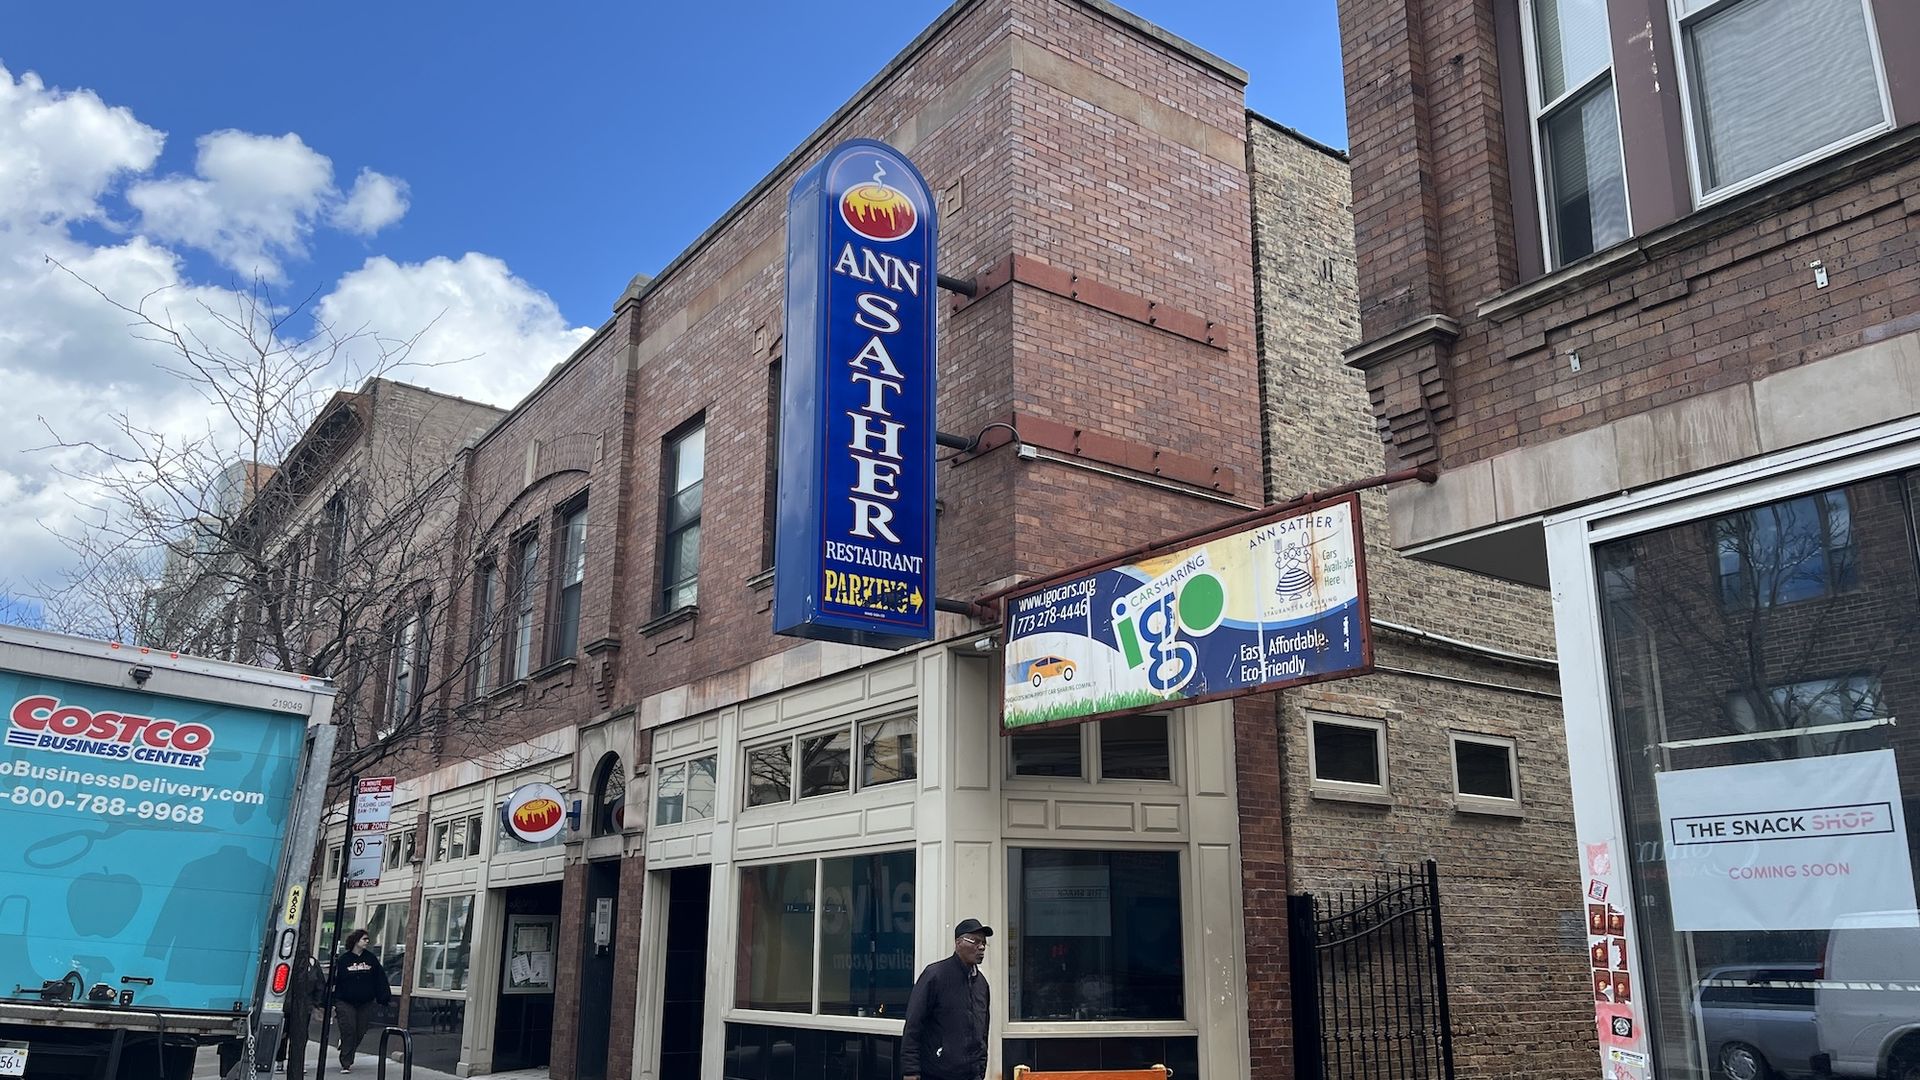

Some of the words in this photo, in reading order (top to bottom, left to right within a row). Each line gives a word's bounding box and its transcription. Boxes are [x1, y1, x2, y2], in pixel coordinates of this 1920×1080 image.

[835, 243, 921, 296] ANN
[847, 294, 905, 543] SATHER
[1249, 527, 1276, 550] ANN
[1280, 516, 1333, 535] SATHER
[826, 540, 922, 574] RESTAURANT
[1322, 549, 1337, 561] Cars
[1324, 557, 1354, 573] Availble
[1324, 575, 1341, 587] Here
[1018, 578, 1097, 612] www.igocars.org
[1305, 596, 1338, 609] CATERING
[1017, 614, 1036, 635] 773
[1037, 598, 1088, 628] 278-4446
[1116, 573, 1224, 690] igo
[1076, 682, 1097, 691] COMPAY
[272, 698, 303, 711] 219049
[12, 696, 212, 752] COSTCO
[37, 734, 131, 758] BUSINESS
[134, 747, 204, 768] CENTER
[360, 785, 380, 793] STANDING
[355, 823, 369, 831] TOW
[371, 822, 388, 830] ZONE
[1687, 821, 1727, 838] THE
[1732, 816, 1806, 836] SNACK
[1811, 811, 1875, 831] SHOP
[1728, 865, 1797, 880] COMING
[1801, 862, 1850, 877] SOON
[361, 879, 377, 887] ZONE
[288, 890, 300, 920] MAXON
[15, 1058, 21, 1068] L
